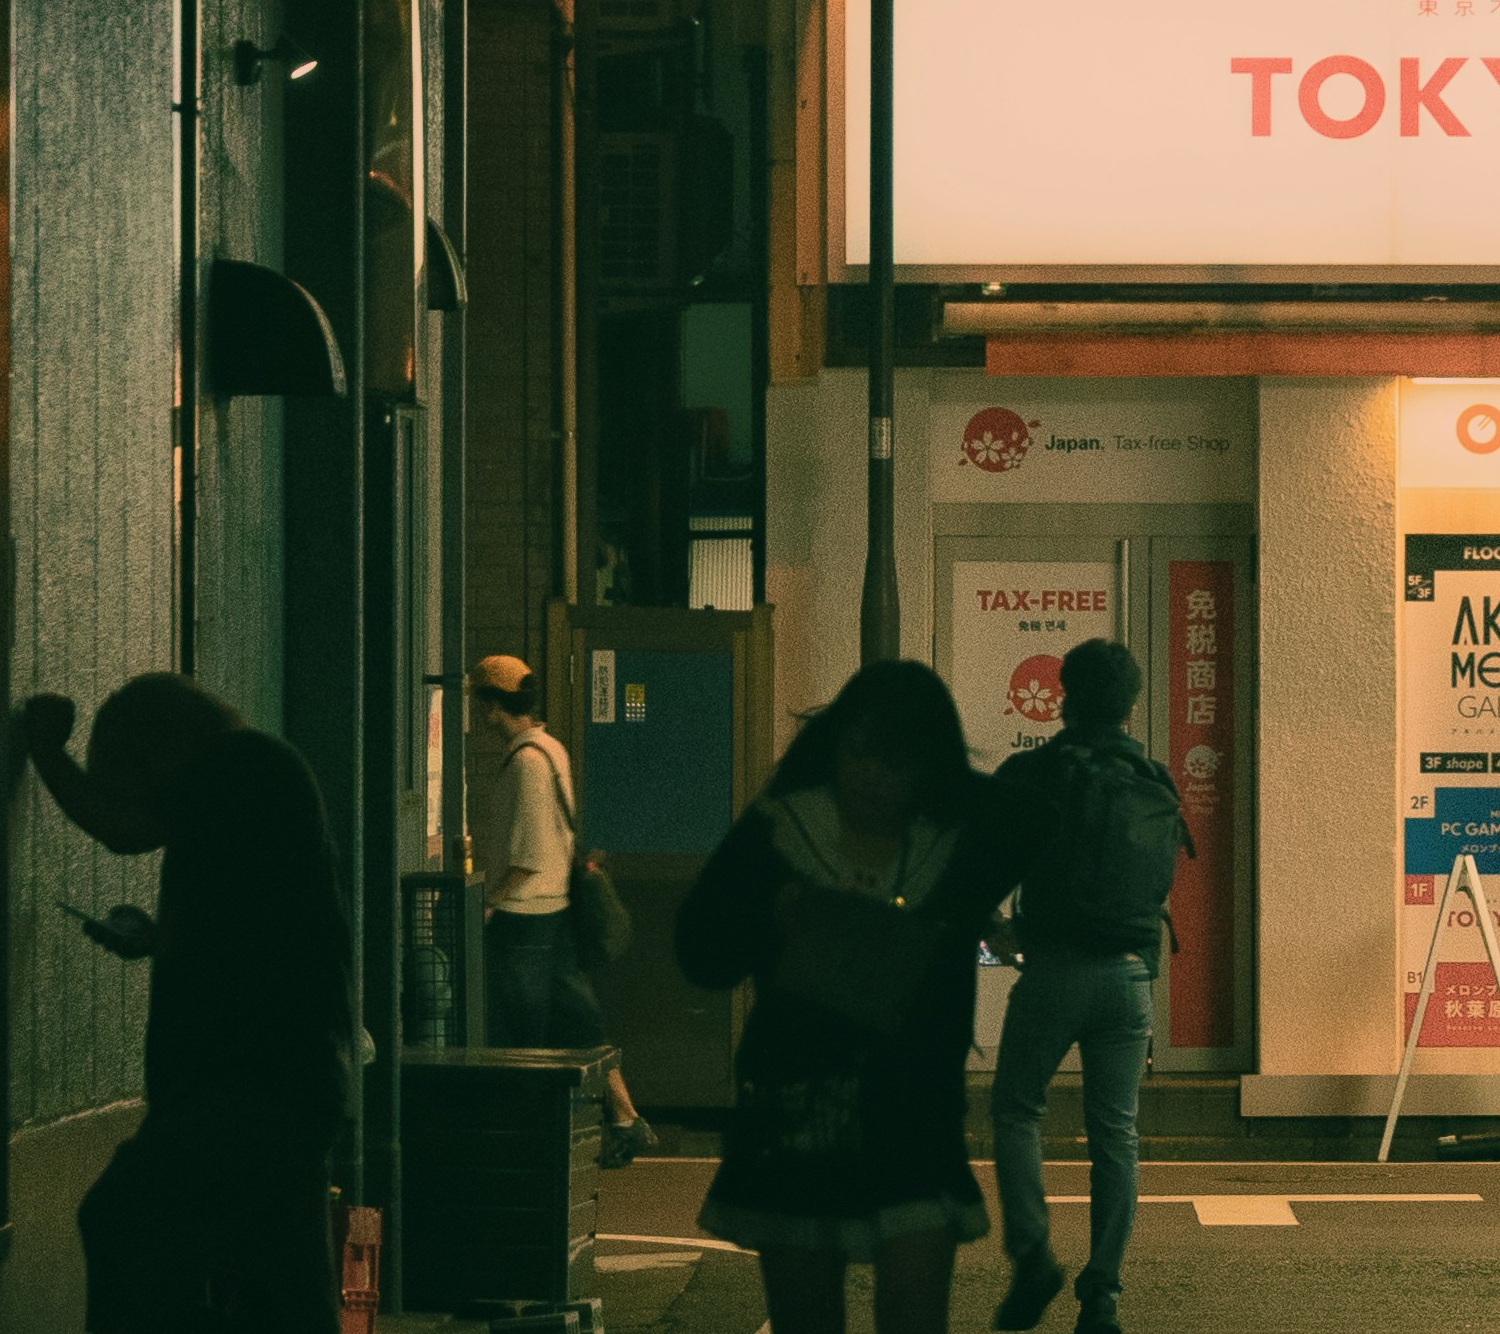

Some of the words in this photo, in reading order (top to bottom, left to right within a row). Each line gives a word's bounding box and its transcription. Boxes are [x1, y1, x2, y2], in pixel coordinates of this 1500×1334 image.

[1114, 435, 1182, 450] Tax-free
[1187, 435, 1230, 453] Shop
[976, 589, 1108, 612] TAX-FREE
[1185, 589, 1218, 725] 免税商店
[1011, 731, 1051, 749] Jap
[1425, 756, 1442, 768] 3F
[1446, 756, 1484, 771] shape
[1411, 796, 1429, 810] 2F
[1440, 822, 1462, 836] PC
[1411, 883, 1429, 898] 1F
